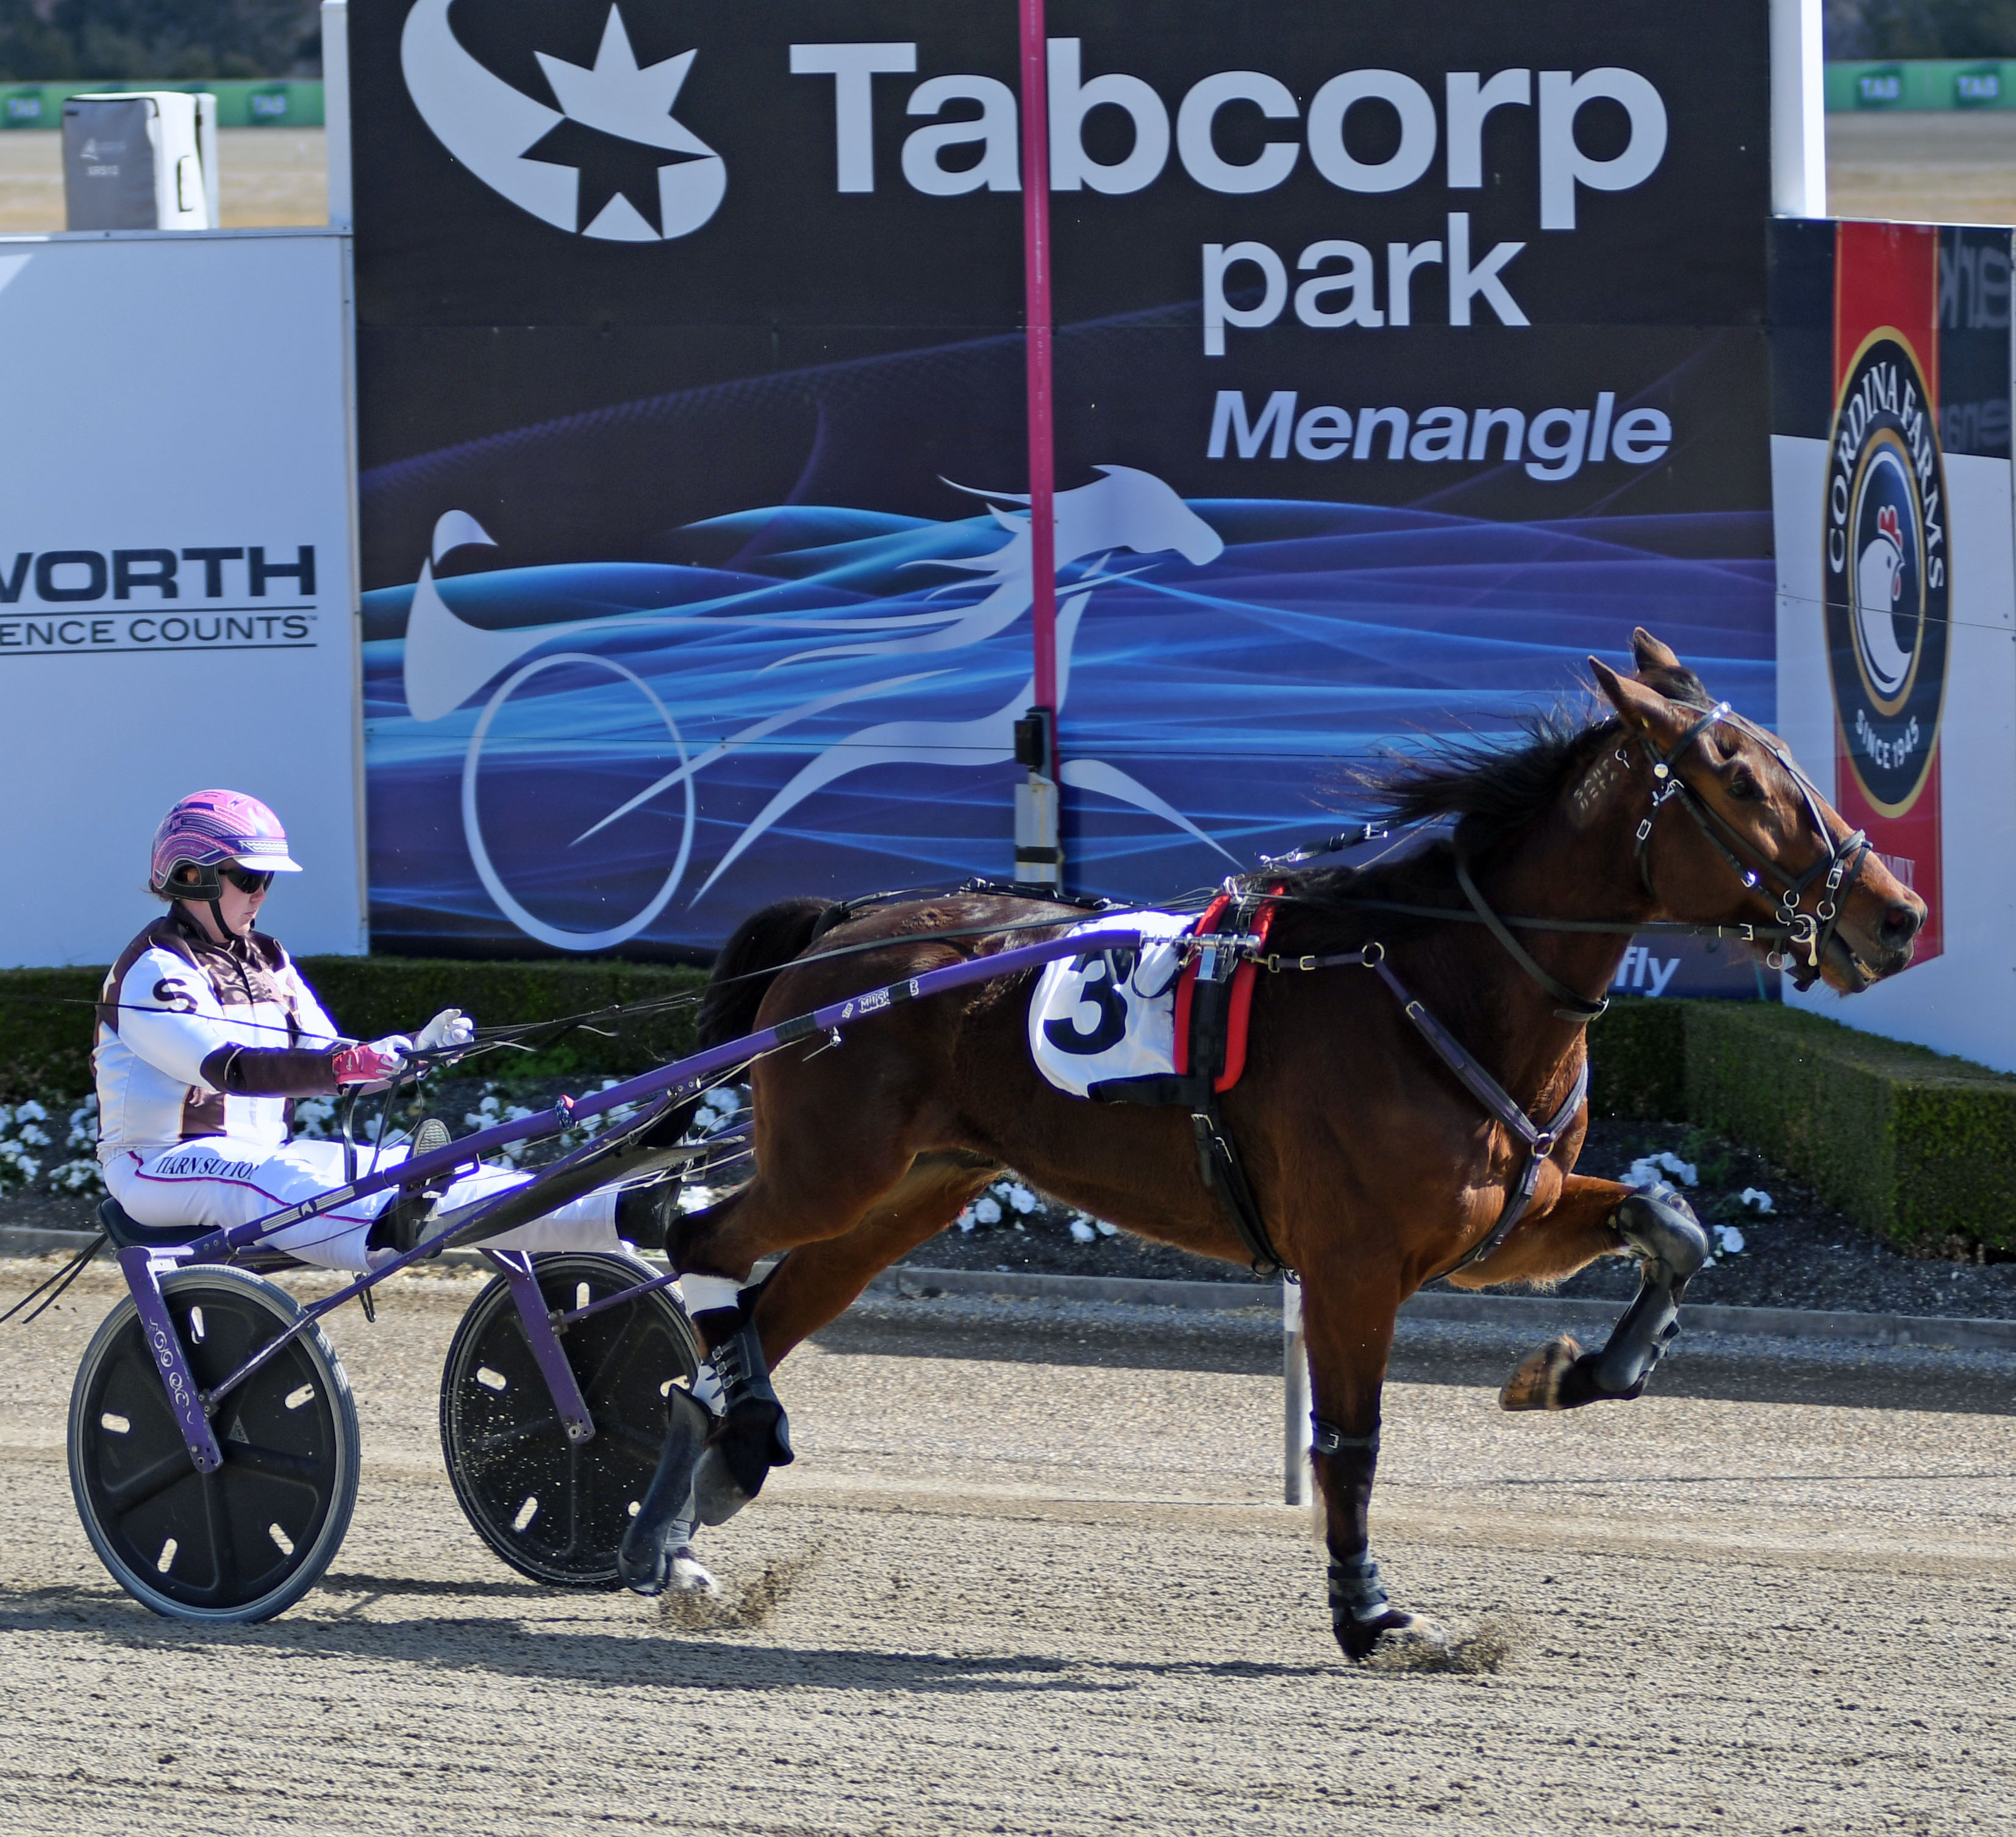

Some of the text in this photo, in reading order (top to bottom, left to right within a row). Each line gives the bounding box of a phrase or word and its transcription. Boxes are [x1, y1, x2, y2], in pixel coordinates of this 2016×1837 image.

[1860, 77, 1900, 99] TAB
[1958, 76, 1998, 98] TAB
[790, 37, 1668, 230] Tabcorp
[1203, 212, 1531, 356] park
[1207, 390, 1673, 481] Menangle
[1829, 362, 1945, 589] CORDINA FARMS
[129, 615, 309, 642] COUNTS
[1856, 709, 1919, 768] SINCE 1945
[152, 978, 198, 1014] S
[1043, 945, 1128, 1055] 3
[1615, 946, 1680, 997] fly
